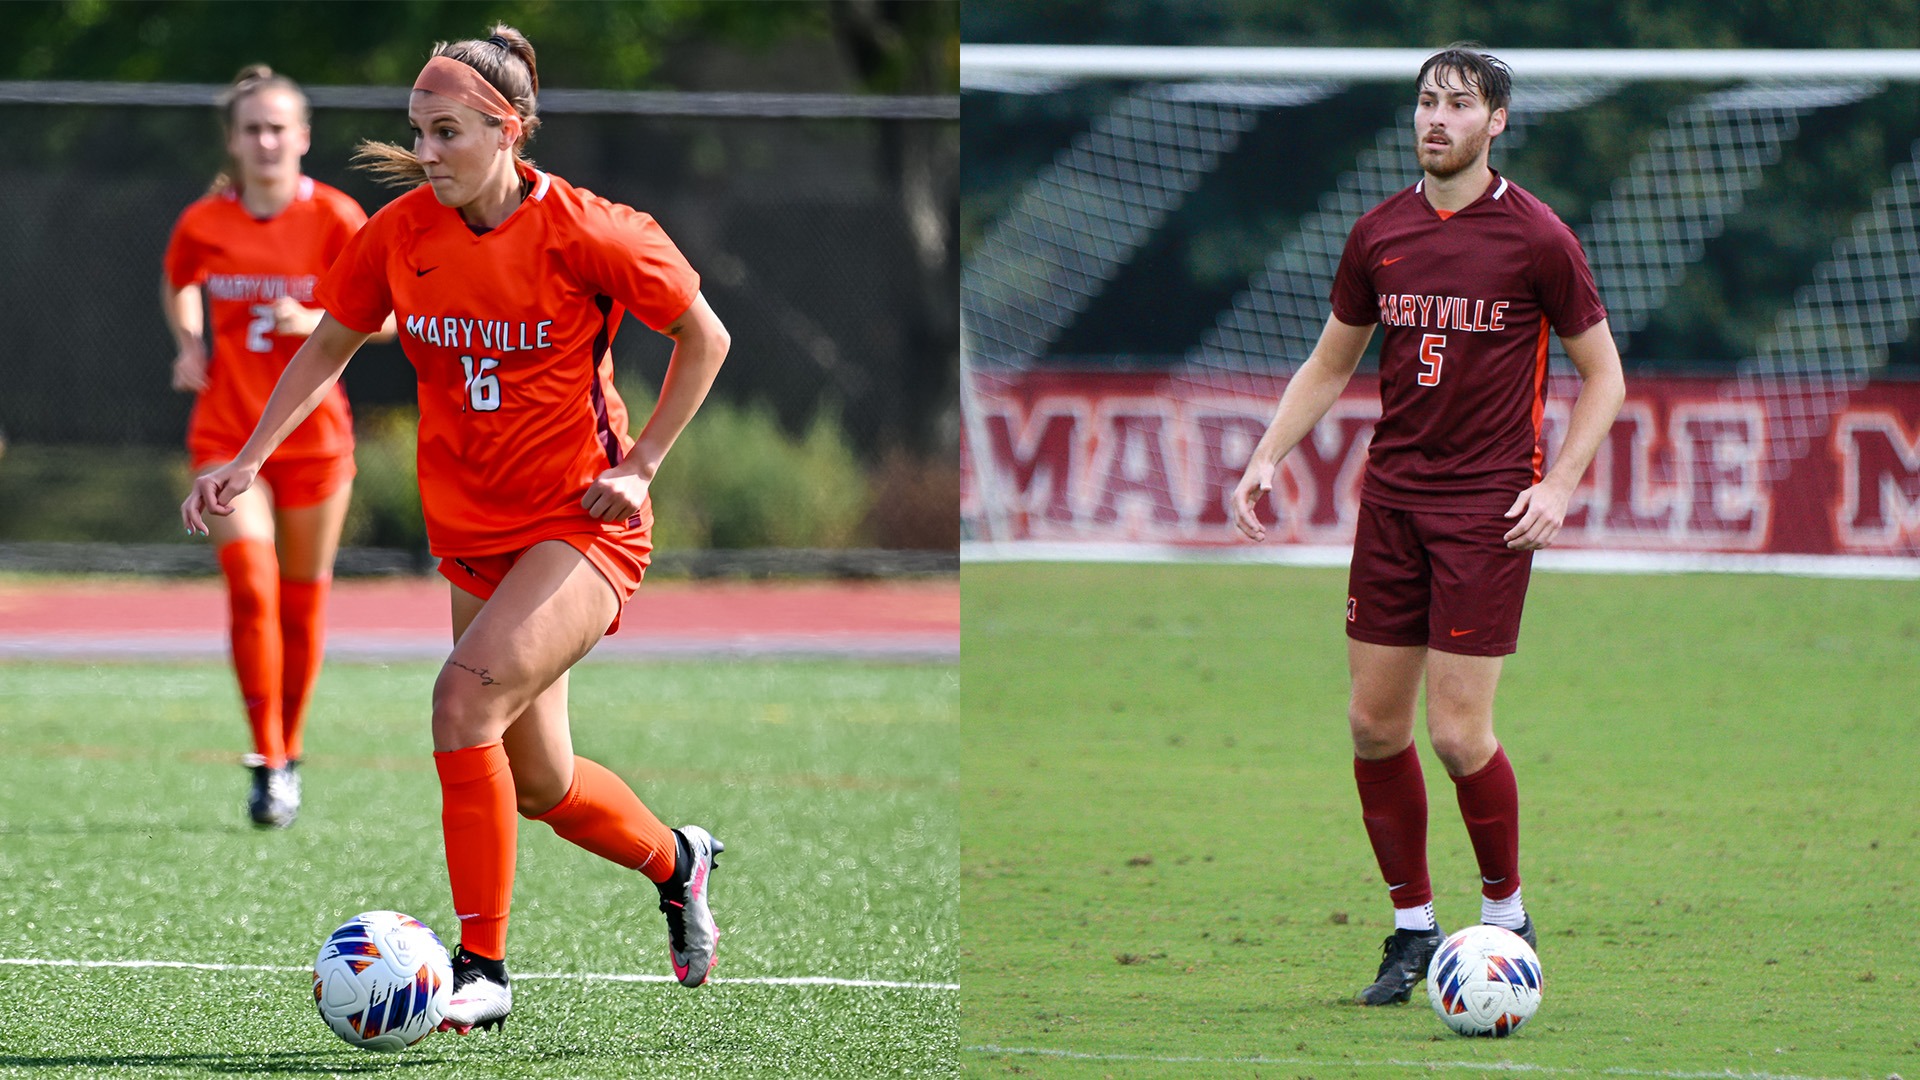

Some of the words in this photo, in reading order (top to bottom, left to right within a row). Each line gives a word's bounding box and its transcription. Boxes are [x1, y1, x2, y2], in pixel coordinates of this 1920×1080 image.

[246, 304, 276, 353] 2
[405, 313, 553, 352] MARYVILLE
[1378, 293, 1509, 332] MARYVILLE
[459, 354, 501, 413] 16
[1417, 333, 1447, 387] 5
